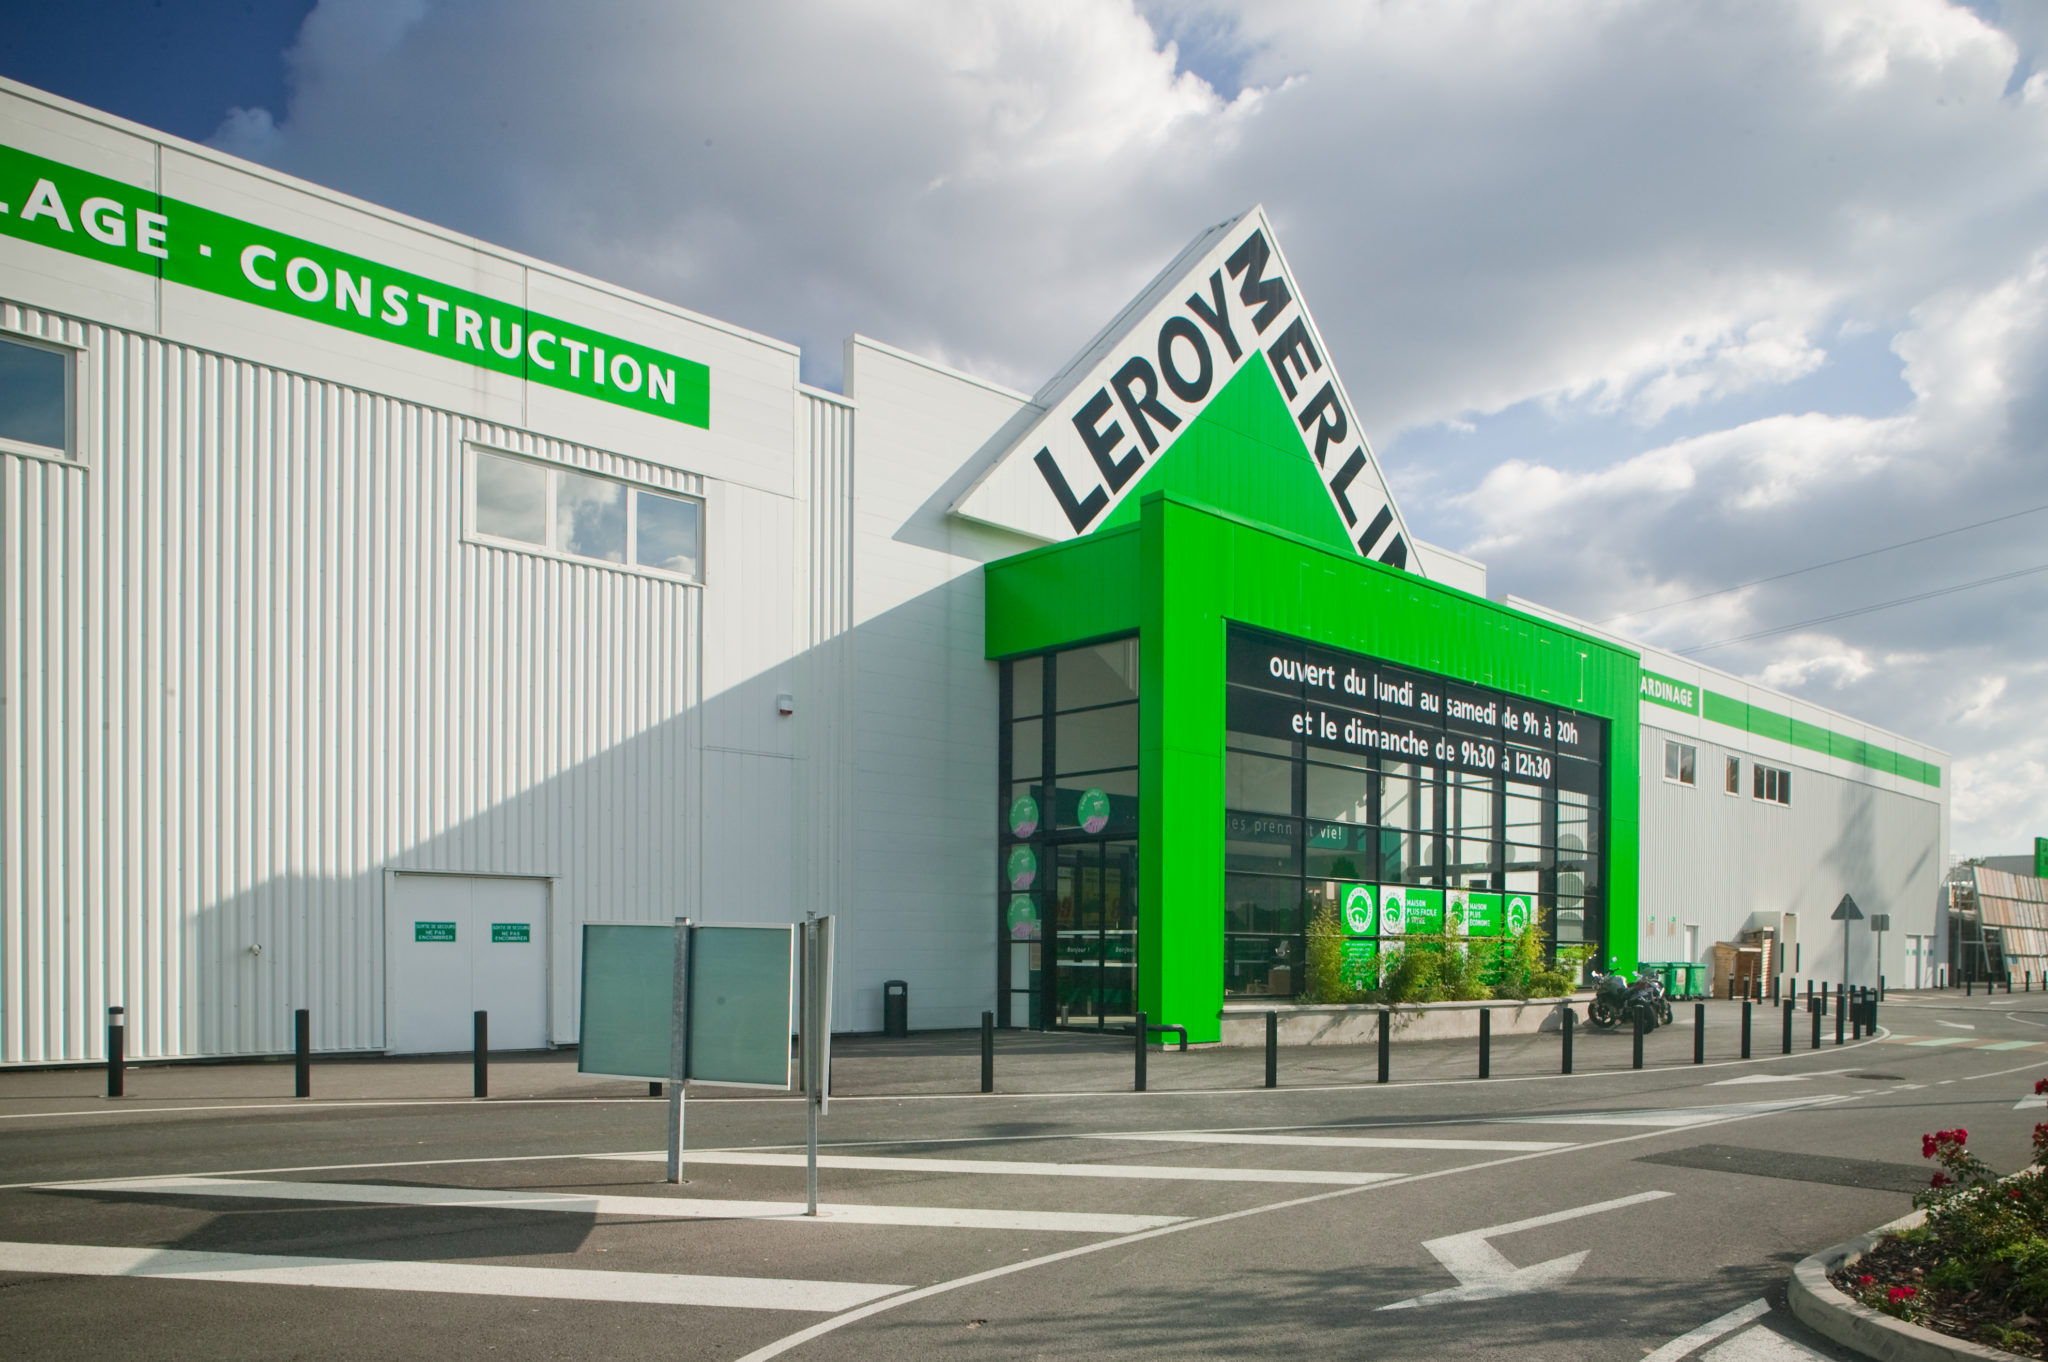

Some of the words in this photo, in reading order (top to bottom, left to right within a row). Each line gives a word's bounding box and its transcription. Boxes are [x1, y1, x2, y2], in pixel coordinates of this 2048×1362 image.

[240, 244, 676, 405] CONSTRUCTION
[1033, 268, 1243, 535] LEROY
[1270, 656, 1336, 690] ouvert
[1344, 668, 1366, 696] du
[1374, 673, 1413, 707] lundi
[1420, 692, 1439, 713] au
[1446, 698, 1496, 726] samedi
[1502, 706, 1518, 731] de
[1523, 712, 1539, 736] 9h
[1543, 715, 1552, 739] à
[1557, 720, 1578, 744] 20h
[1640, 676, 1693, 708] ARDINAGE
[1292, 711, 1313, 735] et
[1321, 711, 1337, 740] le
[1345, 718, 1429, 757] dimanche
[1436, 736, 1455, 761] de
[1461, 741, 1495, 769] 9h30
[1501, 748, 1510, 772] à
[1516, 751, 1551, 779] 12h30
[1254, 820, 1313, 837] prennt
[1320, 825, 1342, 840] vie!
[1407, 899, 1426, 907] MAISON
